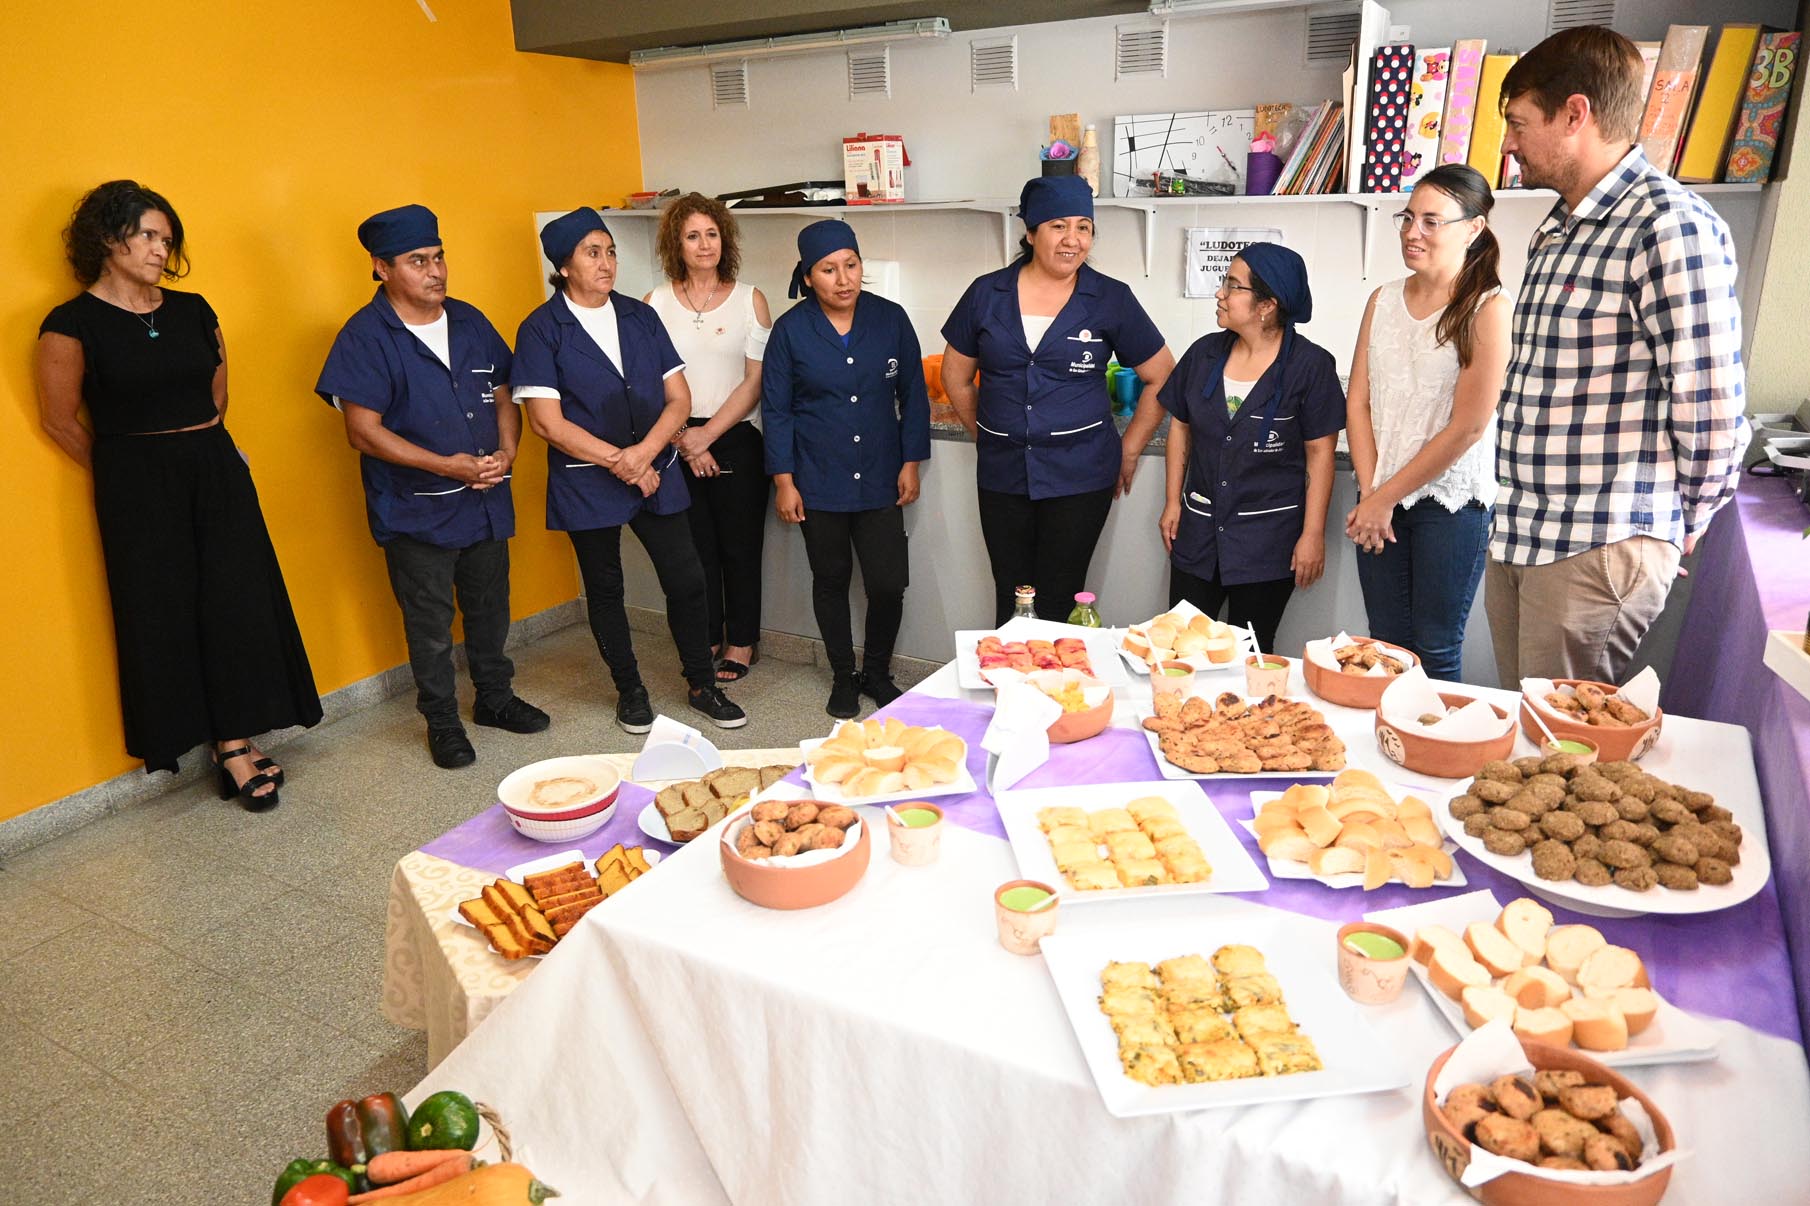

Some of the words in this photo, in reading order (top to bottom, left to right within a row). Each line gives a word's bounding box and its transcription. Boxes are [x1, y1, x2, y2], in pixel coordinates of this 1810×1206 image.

[1750, 47, 1796, 89] 3B
[1451, 48, 1481, 109] SALA
[1221, 114, 1233, 128] 12
[1195, 135, 1205, 147] 10
[1445, 131, 1467, 146] Y
[846, 144, 866, 152] Liliana
[1191, 151, 1197, 161] 9
